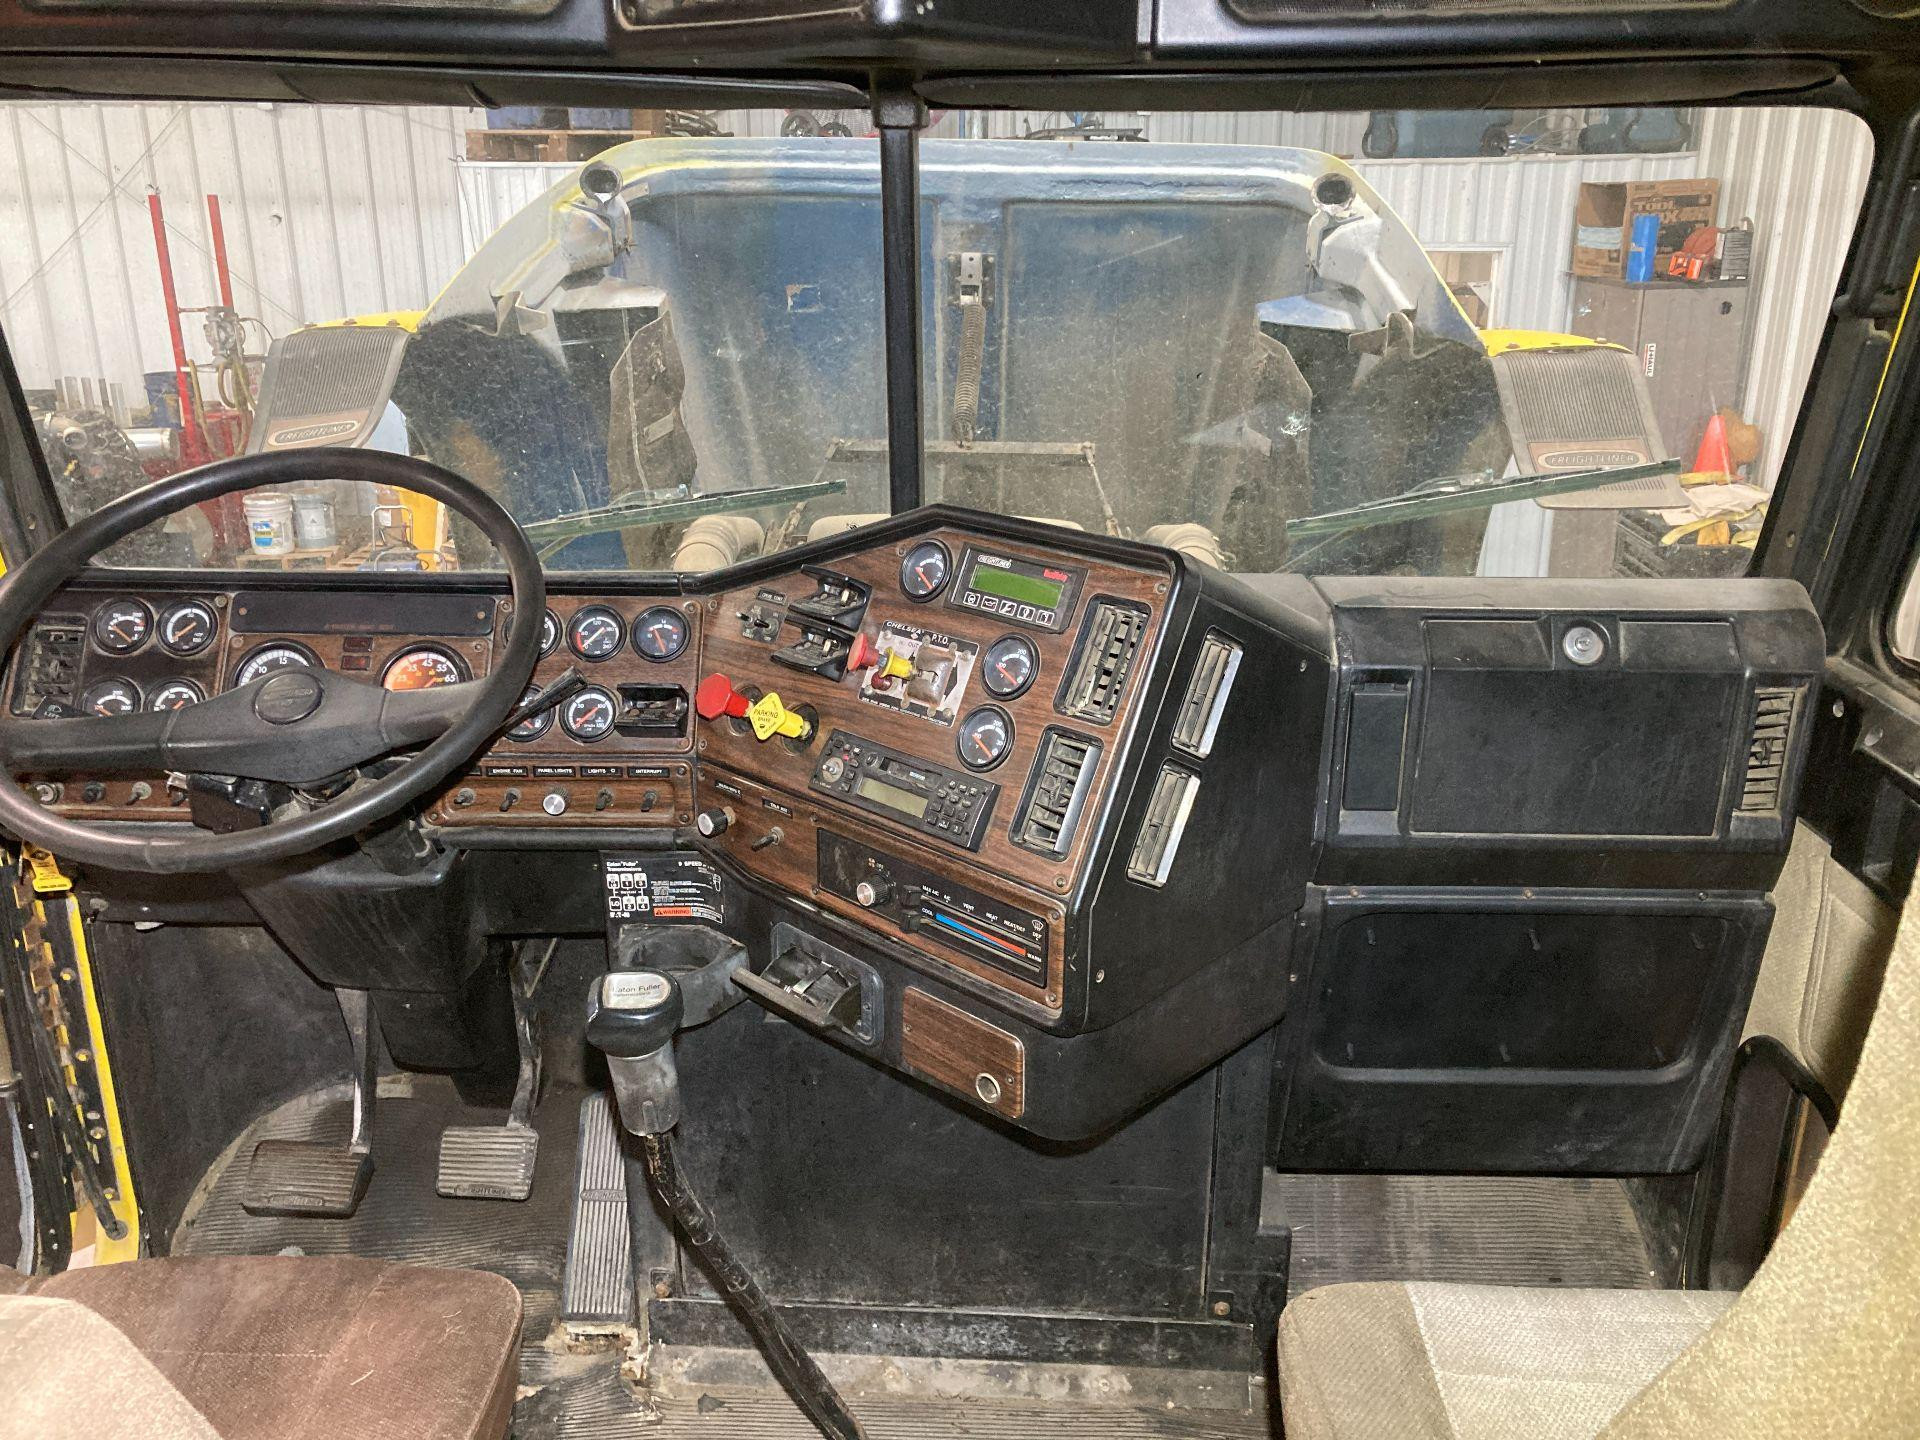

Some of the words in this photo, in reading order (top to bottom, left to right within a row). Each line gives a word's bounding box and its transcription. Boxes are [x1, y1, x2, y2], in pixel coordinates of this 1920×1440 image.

[886, 621, 921, 635] CHELSEA
[279, 656, 288, 665] 15
[422, 659, 433, 667] 45
[258, 665, 267, 674] 10
[436, 663, 447, 671] 55
[444, 674, 456, 682] 65
[753, 708, 779, 719] PARKING
[638, 983, 661, 992] Fuller
